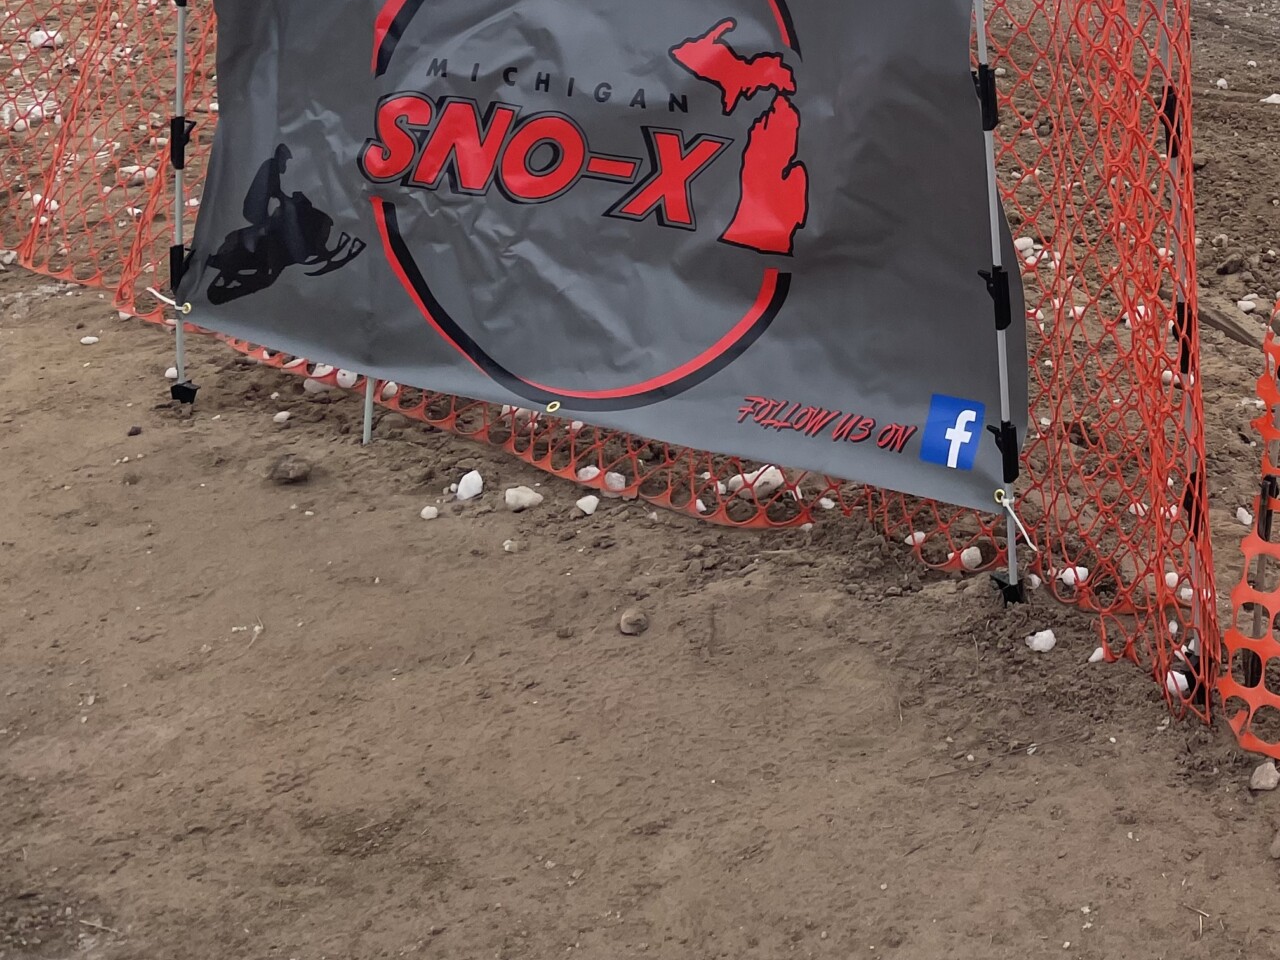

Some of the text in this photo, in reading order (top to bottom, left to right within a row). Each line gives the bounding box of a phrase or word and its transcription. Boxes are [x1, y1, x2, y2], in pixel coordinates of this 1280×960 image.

[425, 57, 689, 114] MICHIGAN
[357, 90, 735, 232] SNO-X
[737, 395, 842, 440] FOLLOW
[831, 412, 877, 443] US
[876, 423, 919, 454] ON
